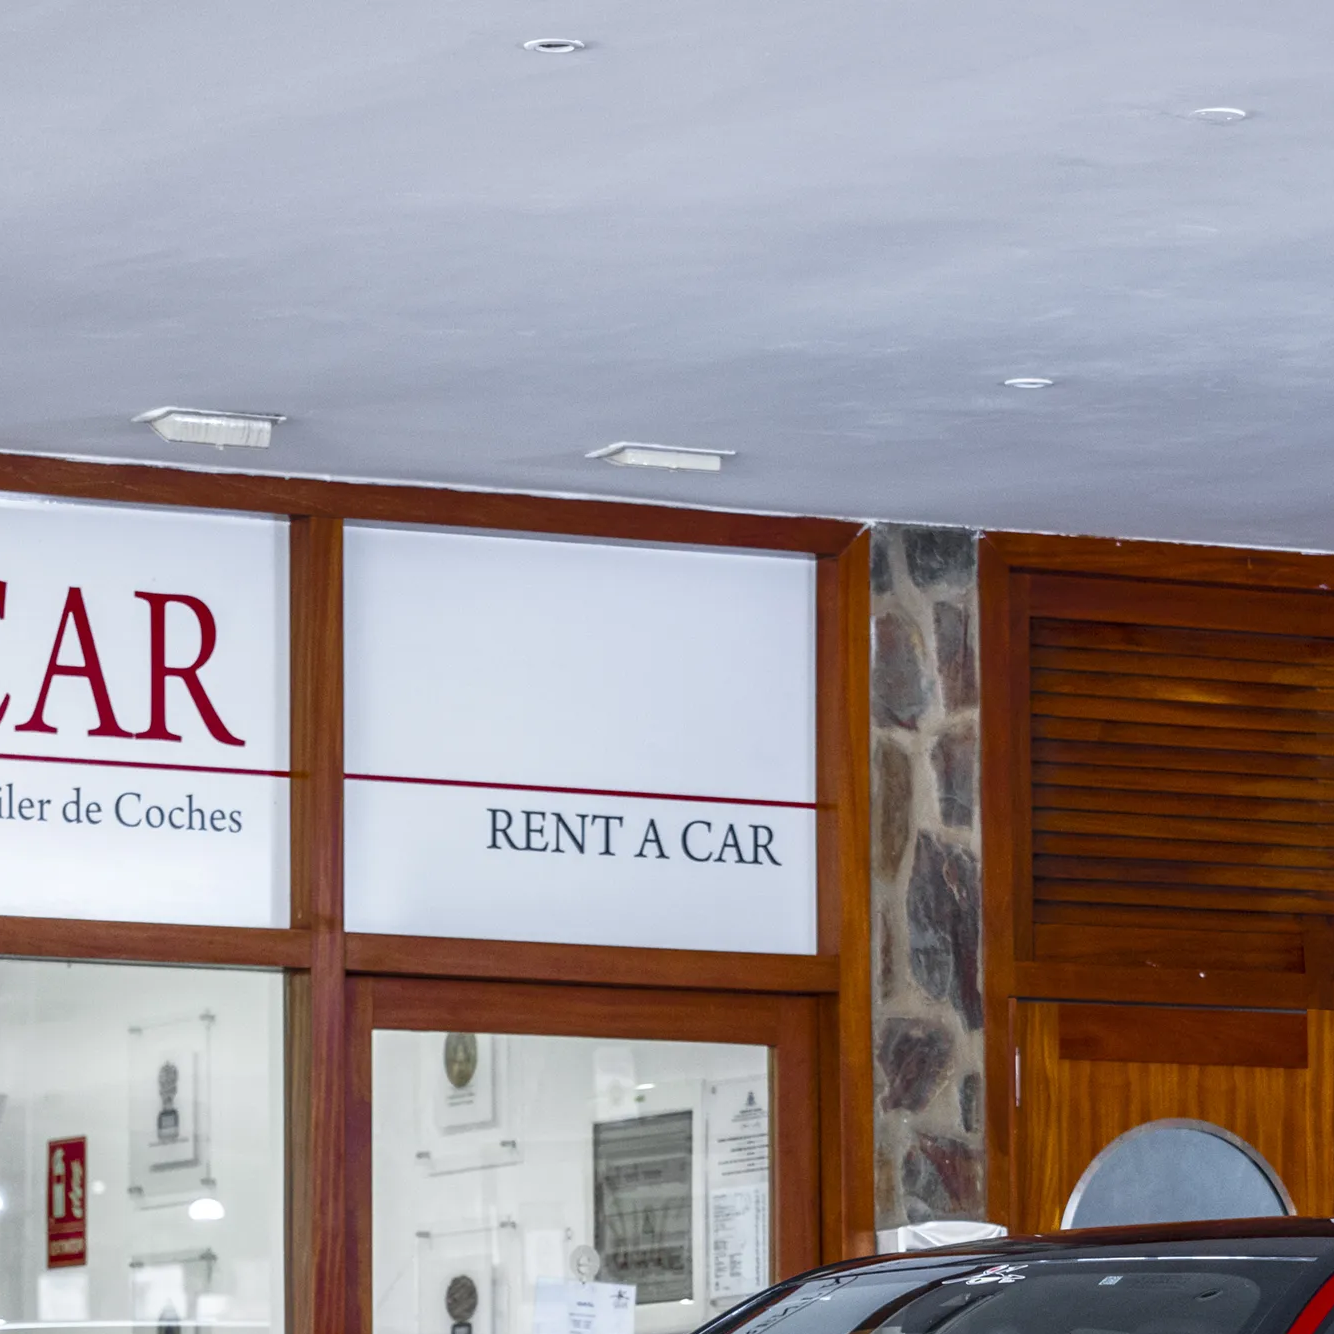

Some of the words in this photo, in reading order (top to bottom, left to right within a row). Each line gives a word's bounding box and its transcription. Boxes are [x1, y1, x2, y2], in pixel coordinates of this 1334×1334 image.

[62, 787, 102, 824] de
[115, 792, 243, 833] Coches
[486, 808, 623, 856] RENT
[634, 818, 670, 860] A
[681, 821, 782, 866] CAR
